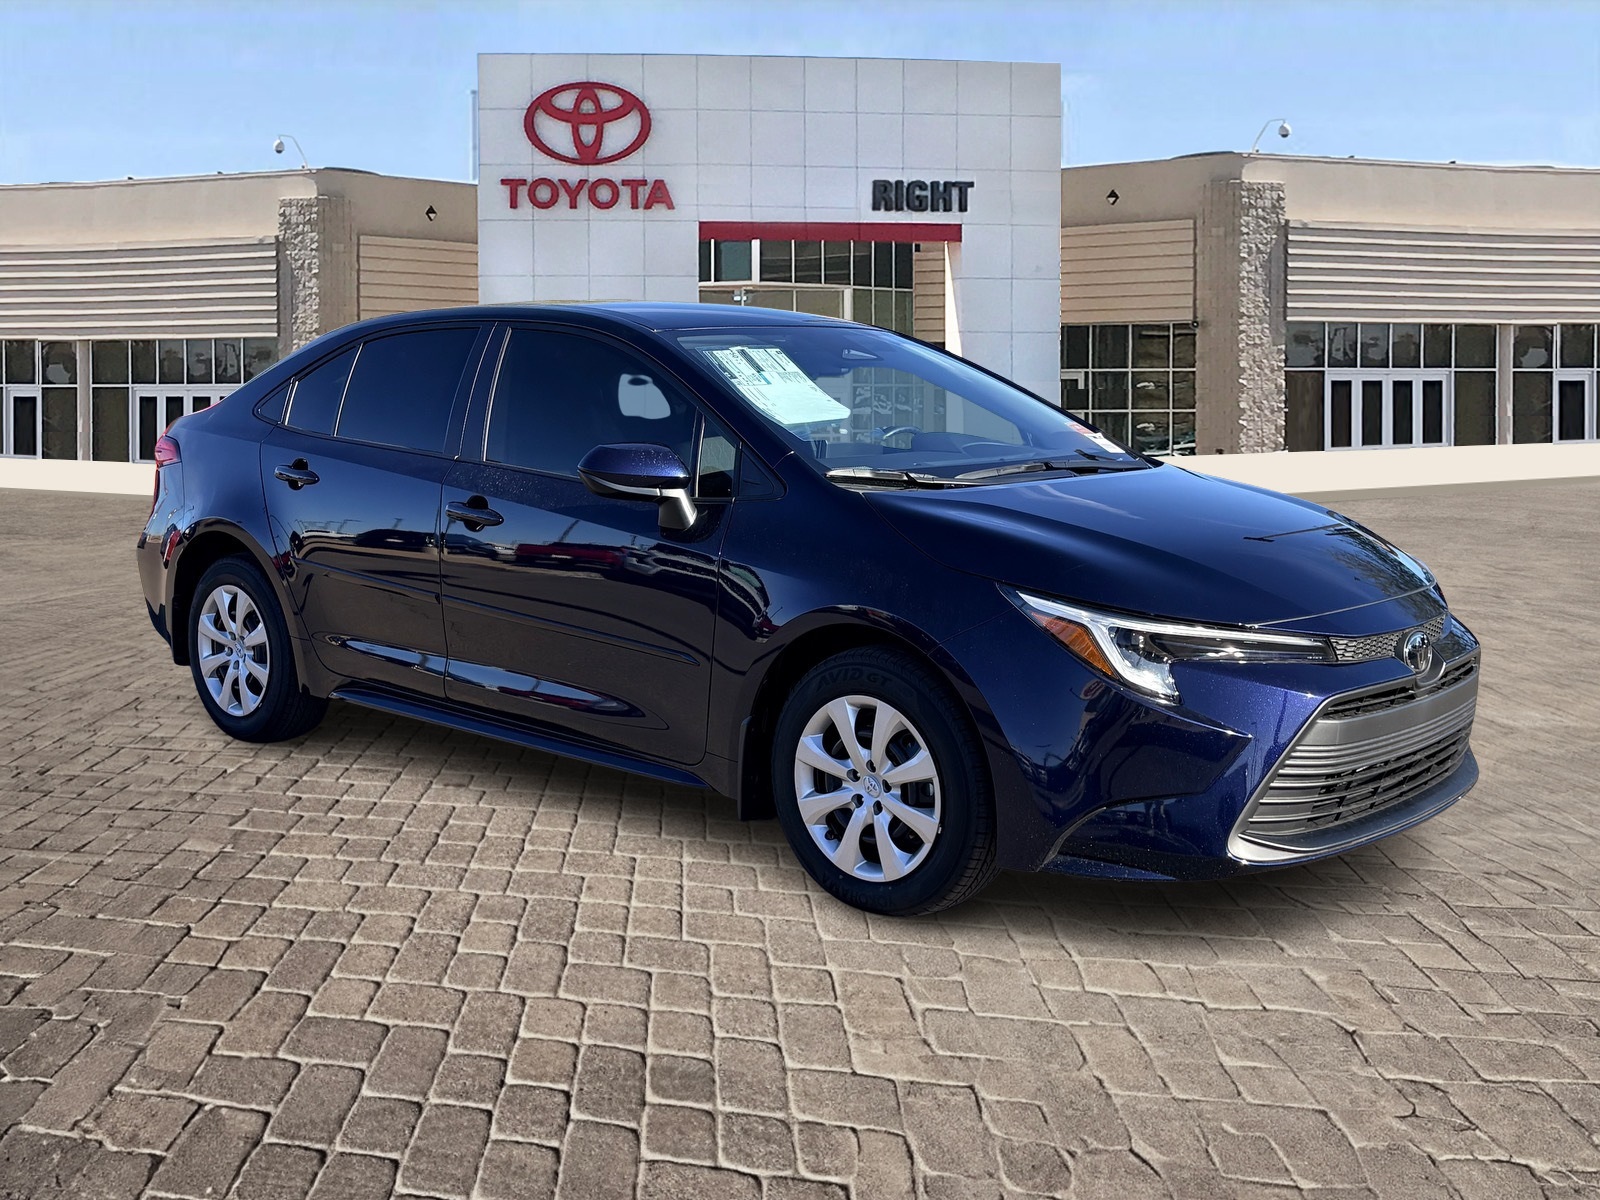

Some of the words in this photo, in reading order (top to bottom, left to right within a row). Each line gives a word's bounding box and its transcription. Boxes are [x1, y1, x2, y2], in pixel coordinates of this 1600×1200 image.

[501, 178, 674, 210] TOYOTA
[872, 180, 975, 212] RIGHT
[816, 667, 863, 692] AVID
[866, 673, 893, 686] GT
